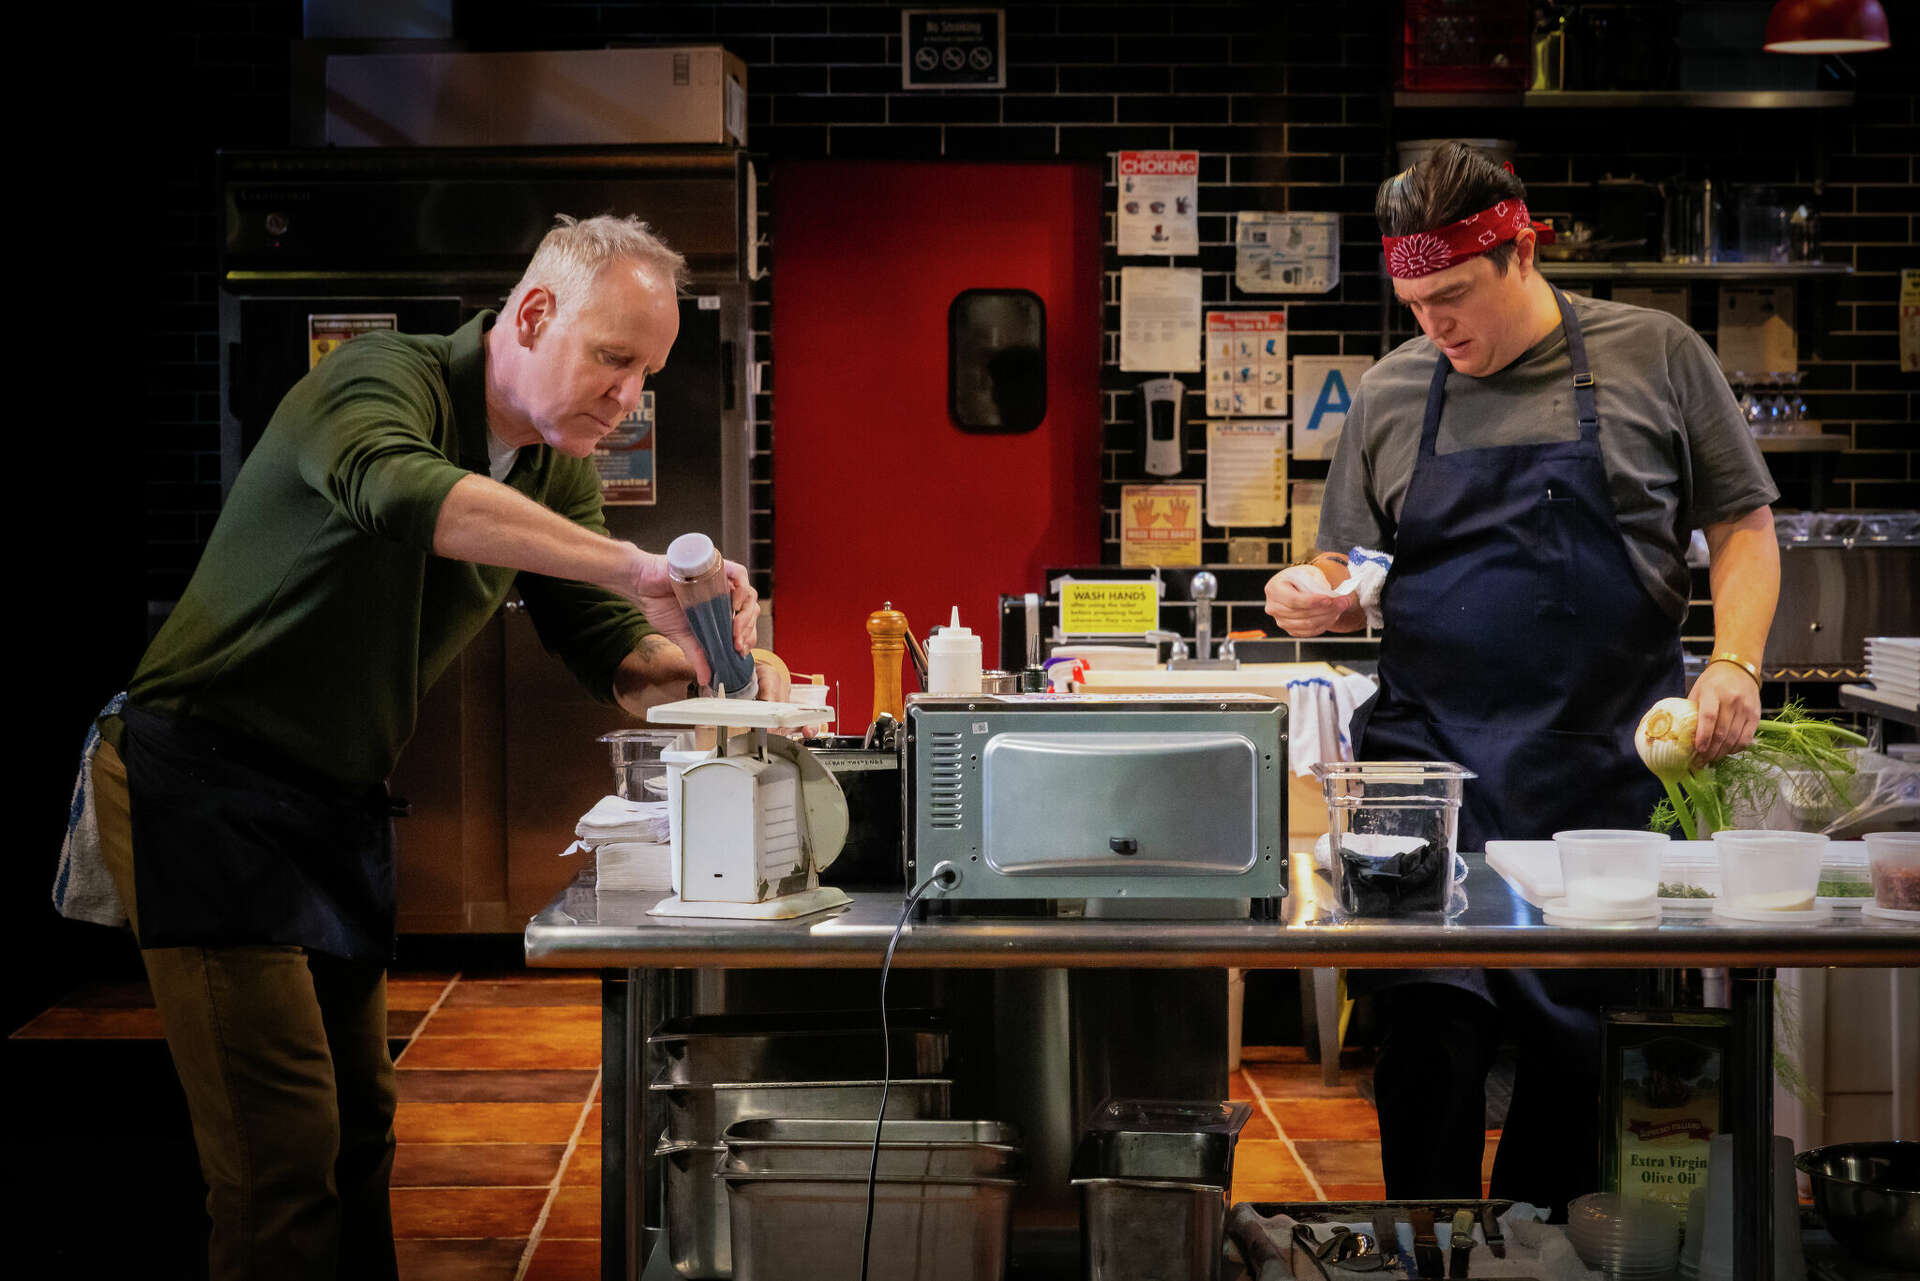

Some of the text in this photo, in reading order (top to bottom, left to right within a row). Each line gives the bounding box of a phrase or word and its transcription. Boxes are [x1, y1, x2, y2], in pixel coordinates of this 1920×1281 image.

[1121, 159, 1196, 174] CHOKING
[1304, 367, 1346, 422] A
[1073, 591, 1146, 600] WASH HANDS
[1631, 1154, 1708, 1172] Extra Virgin
[1641, 1171, 1697, 1185] Olive Oil
